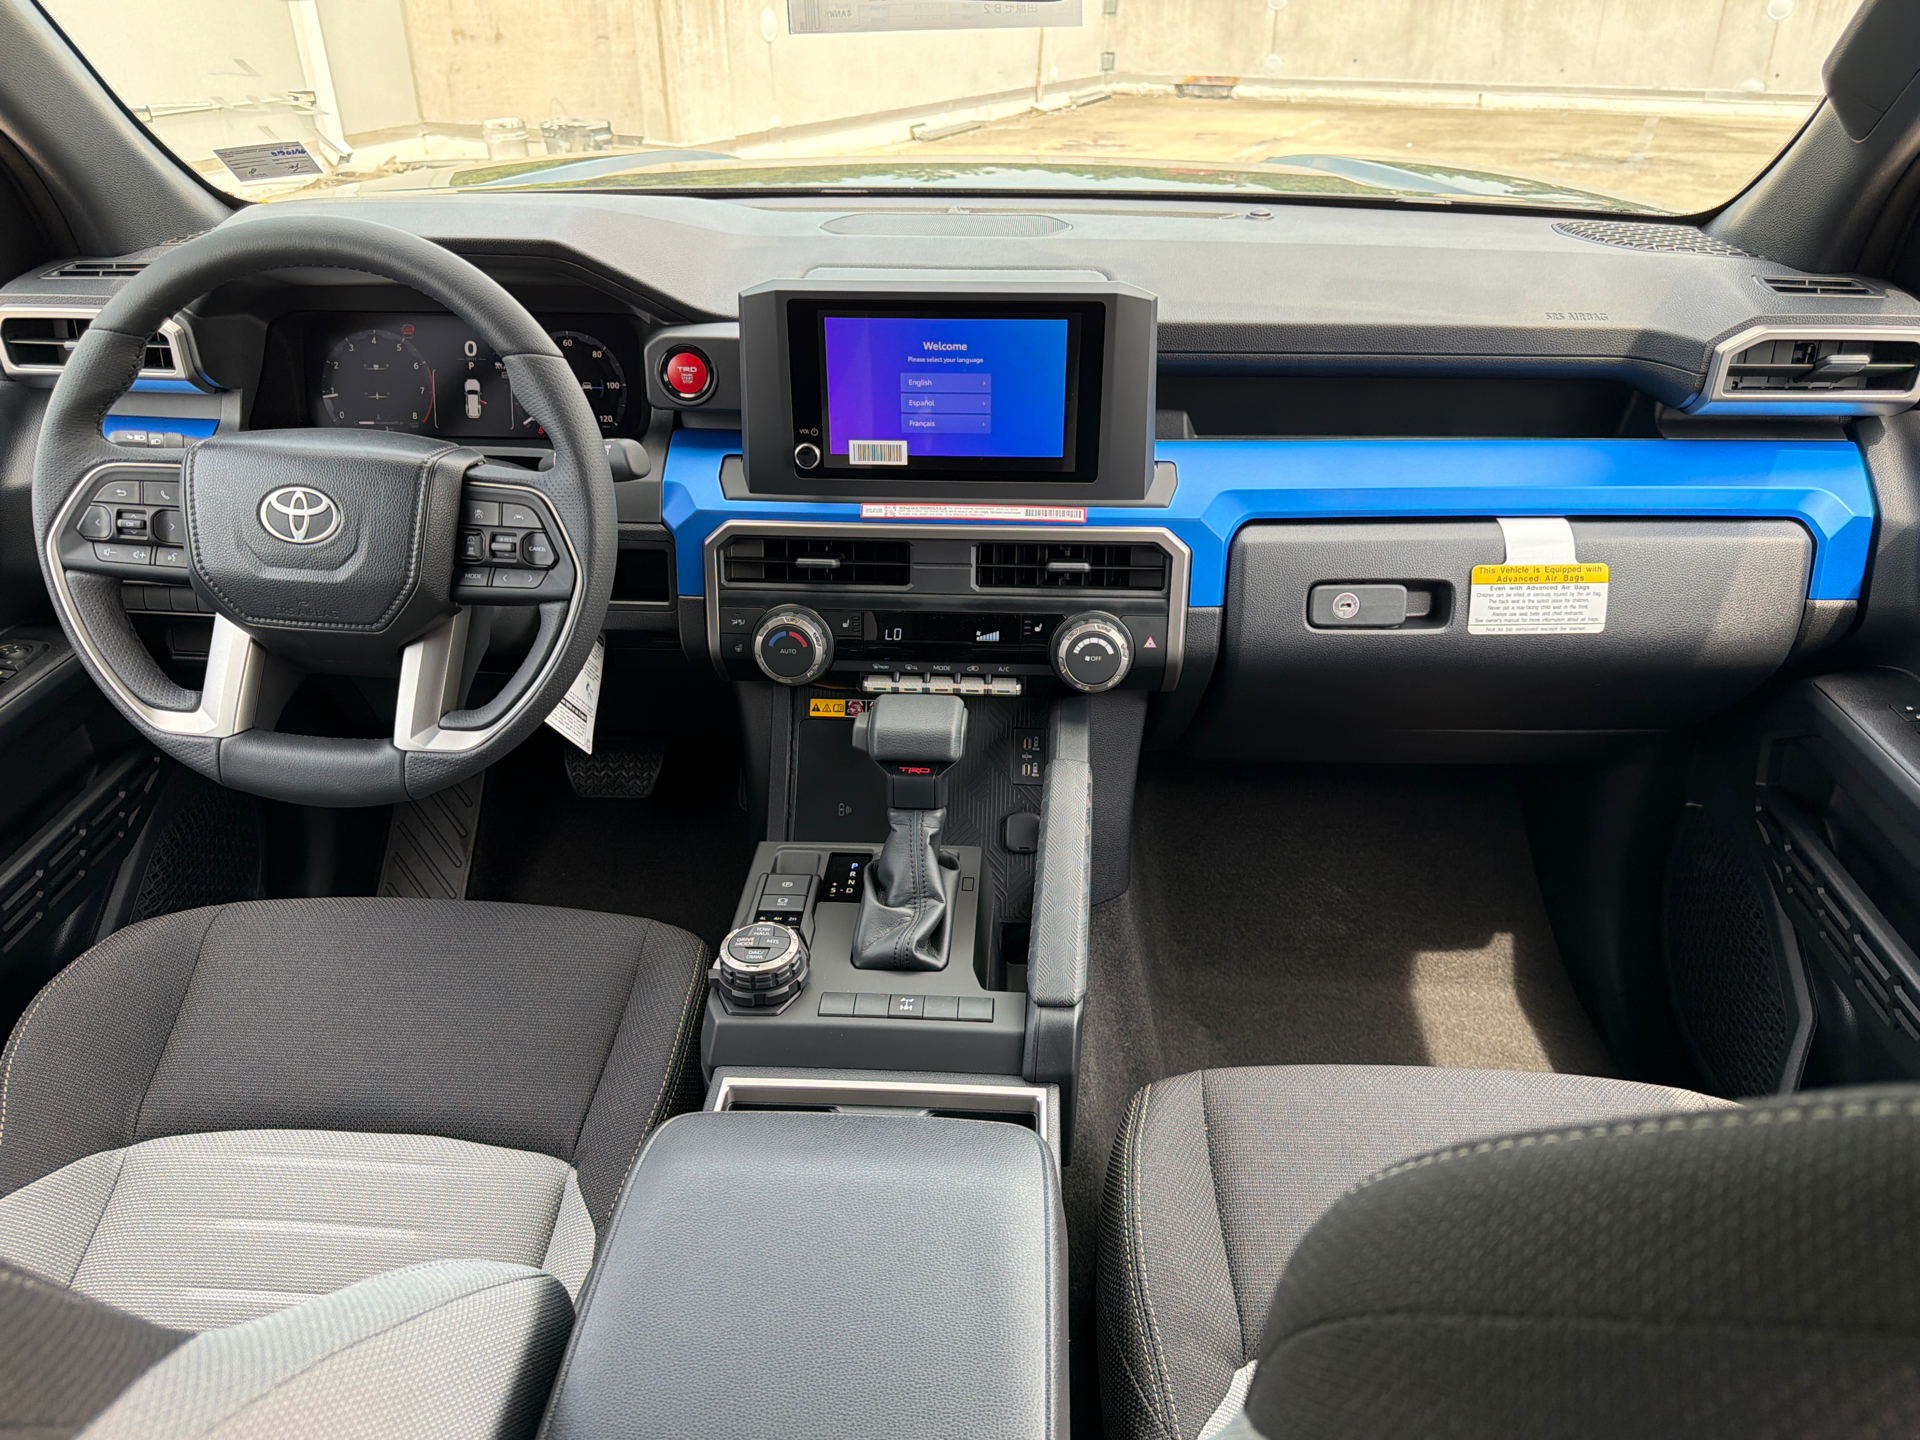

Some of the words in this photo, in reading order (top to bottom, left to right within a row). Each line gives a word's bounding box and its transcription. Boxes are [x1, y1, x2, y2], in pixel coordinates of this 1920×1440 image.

[1544, 312, 1565, 321] SRS
[1567, 312, 1609, 321] AIRBAG
[464, 340, 478, 357] 0
[923, 341, 968, 351] Welcome
[956, 356, 984, 365] language
[468, 362, 475, 370] P
[908, 379, 933, 387] English
[599, 415, 613, 423] 120
[909, 420, 936, 428] Français
[1544, 566, 1582, 575] Equipped
[1496, 575, 1539, 583] Advanced
[1563, 575, 1585, 583] Bags
[899, 766, 930, 775] TRD
